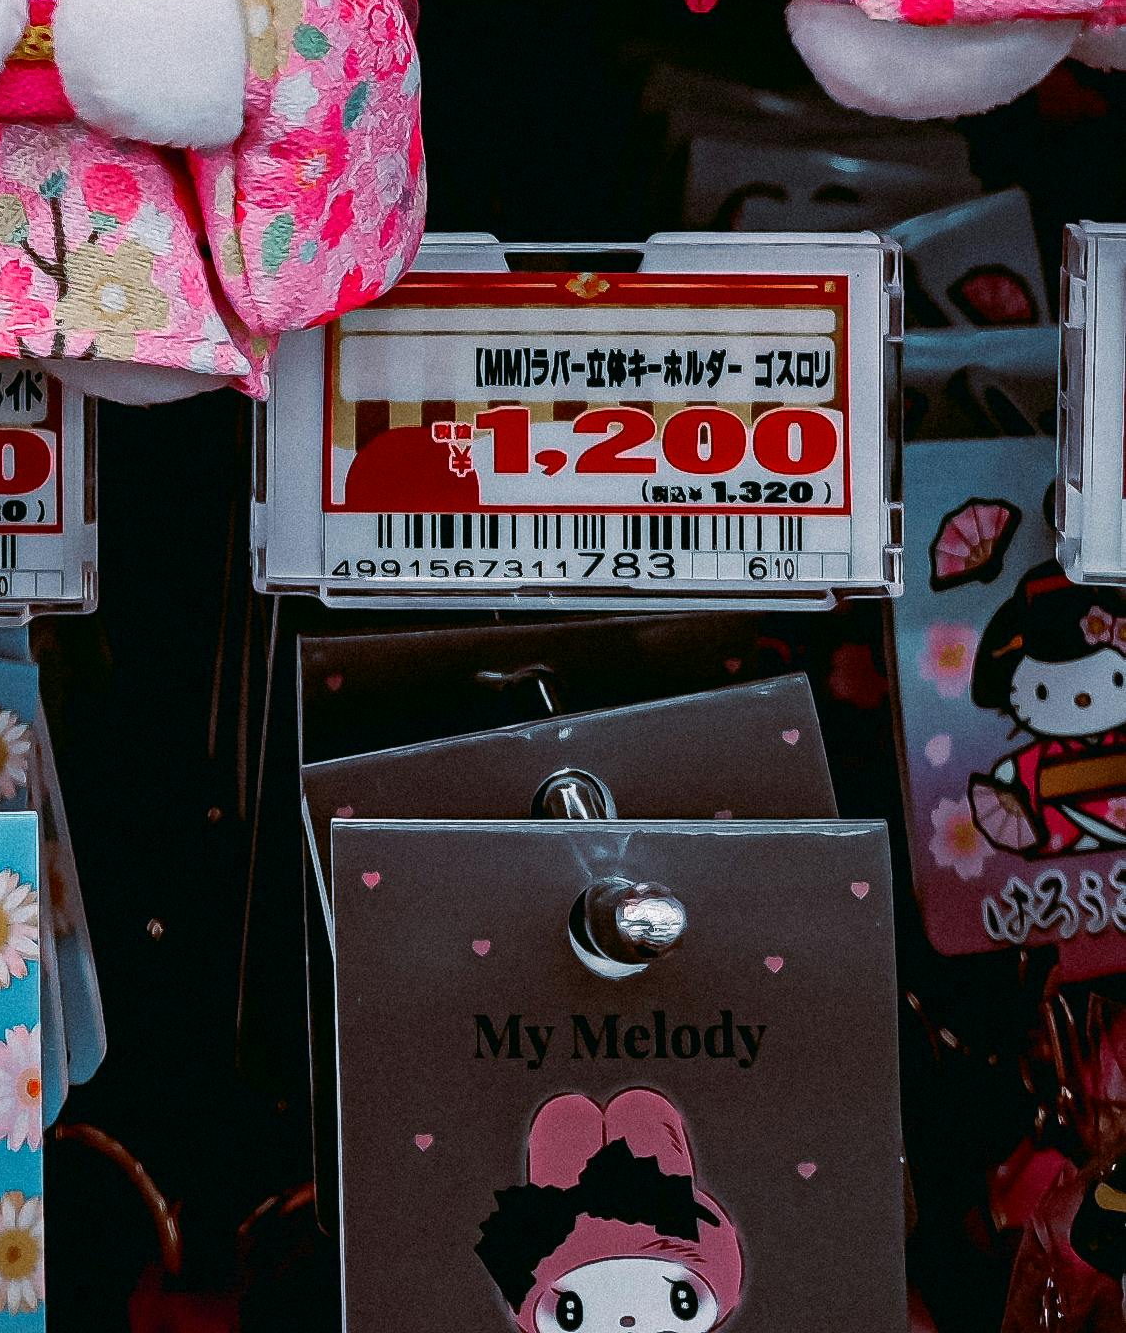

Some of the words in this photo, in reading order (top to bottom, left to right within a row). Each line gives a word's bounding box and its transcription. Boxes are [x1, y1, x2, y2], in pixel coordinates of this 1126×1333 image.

[753, 349, 832, 388] ゴスロリ
[475, 407, 839, 477] 1,200
[474, 1012, 557, 1070] My
[571, 1010, 767, 1069] Melody
